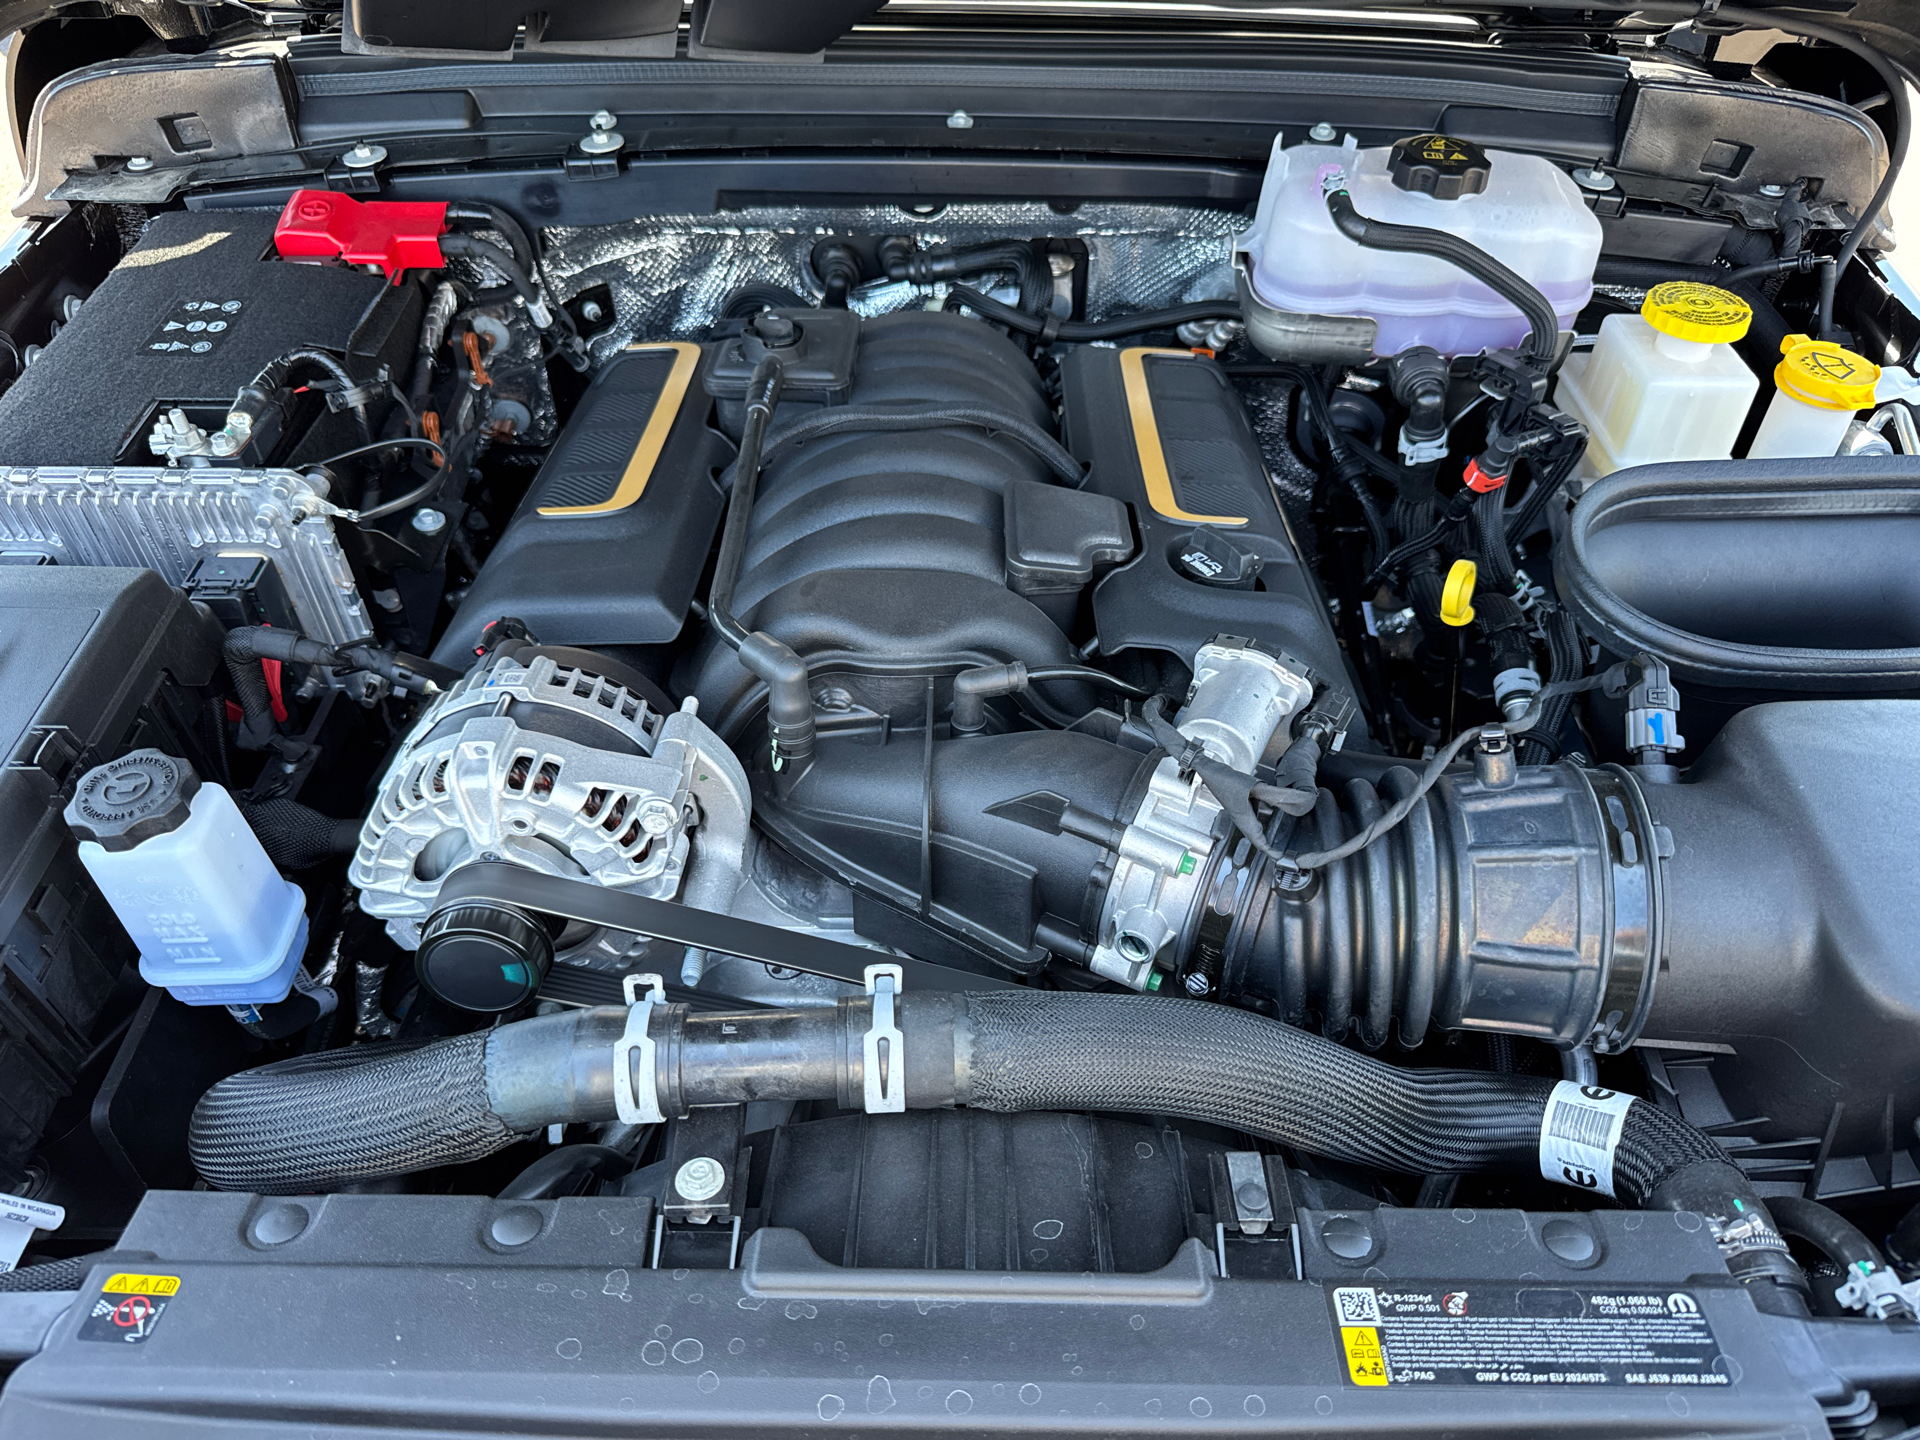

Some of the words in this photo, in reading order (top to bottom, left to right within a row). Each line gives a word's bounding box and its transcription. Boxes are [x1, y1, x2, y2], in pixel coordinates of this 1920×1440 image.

[1190, 560, 1216, 577] ENGINE
[147, 912, 196, 926] COLD
[152, 925, 205, 938] MAX
[166, 947, 217, 959] MIN
[27, 1205, 57, 1216] NICARAGUA
[1396, 1304, 1417, 1312] GWP
[1418, 1304, 1440, 1312] 0.501
[1599, 1306, 1618, 1314] CO2
[1414, 1371, 1435, 1381] PAG
[1475, 1372, 1497, 1382] GWP
[1500, 1373, 1509, 1382] &
[1510, 1373, 1531, 1382] CO2
[1532, 1374, 1548, 1384] per
[1549, 1373, 1564, 1382] EU
[1565, 1373, 1606, 1383] 2024/573
[1625, 1373, 1646, 1383] SAE
